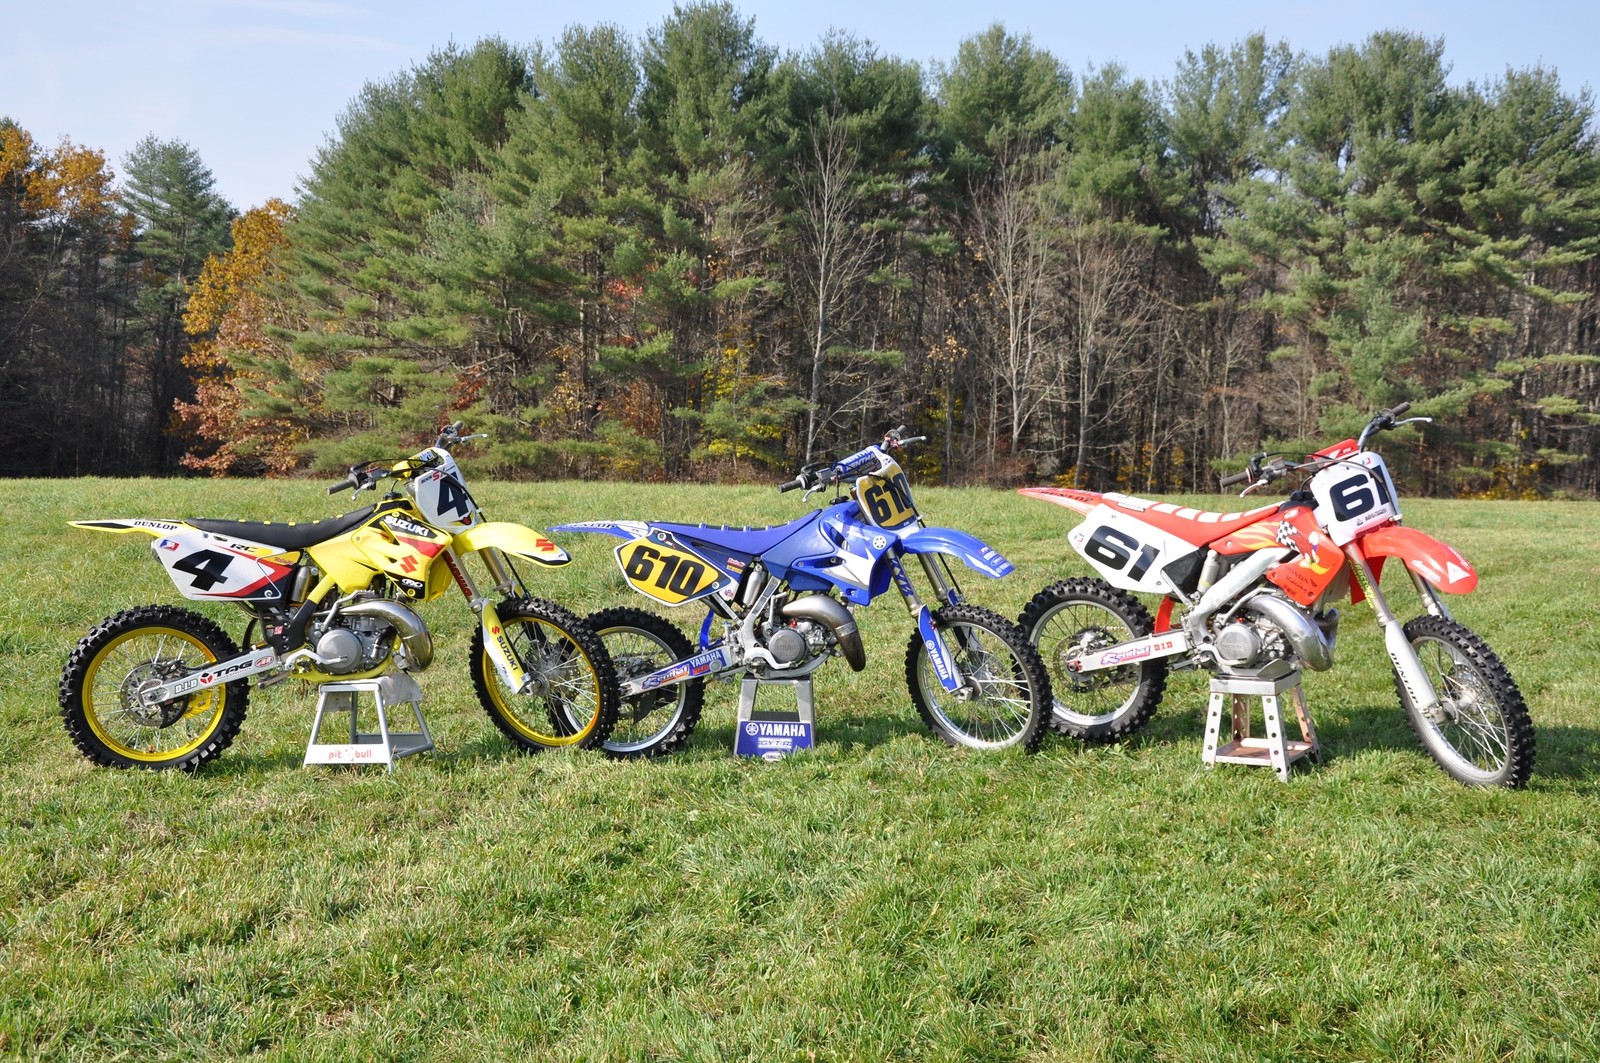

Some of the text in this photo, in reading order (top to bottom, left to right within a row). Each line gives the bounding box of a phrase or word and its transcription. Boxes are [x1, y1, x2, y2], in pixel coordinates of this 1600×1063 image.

[437, 471, 469, 518] 4
[865, 473, 910, 524] 610
[1330, 465, 1390, 522] 61
[133, 521, 178, 531] DUNLOP
[383, 515, 430, 537] SUZUKI
[172, 549, 235, 591] 4
[625, 545, 705, 597] 610
[1084, 525, 1160, 582] 61
[213, 660, 253, 678] TAG
[496, 635, 518, 671] SUZUKI
[690, 650, 722, 668] YAMAHA
[929, 647, 949, 681] YAMAHA
[1391, 652, 1419, 704] DUNLOP
[760, 723, 806, 737] YAMAHA
[328, 749, 372, 760] pit bull
